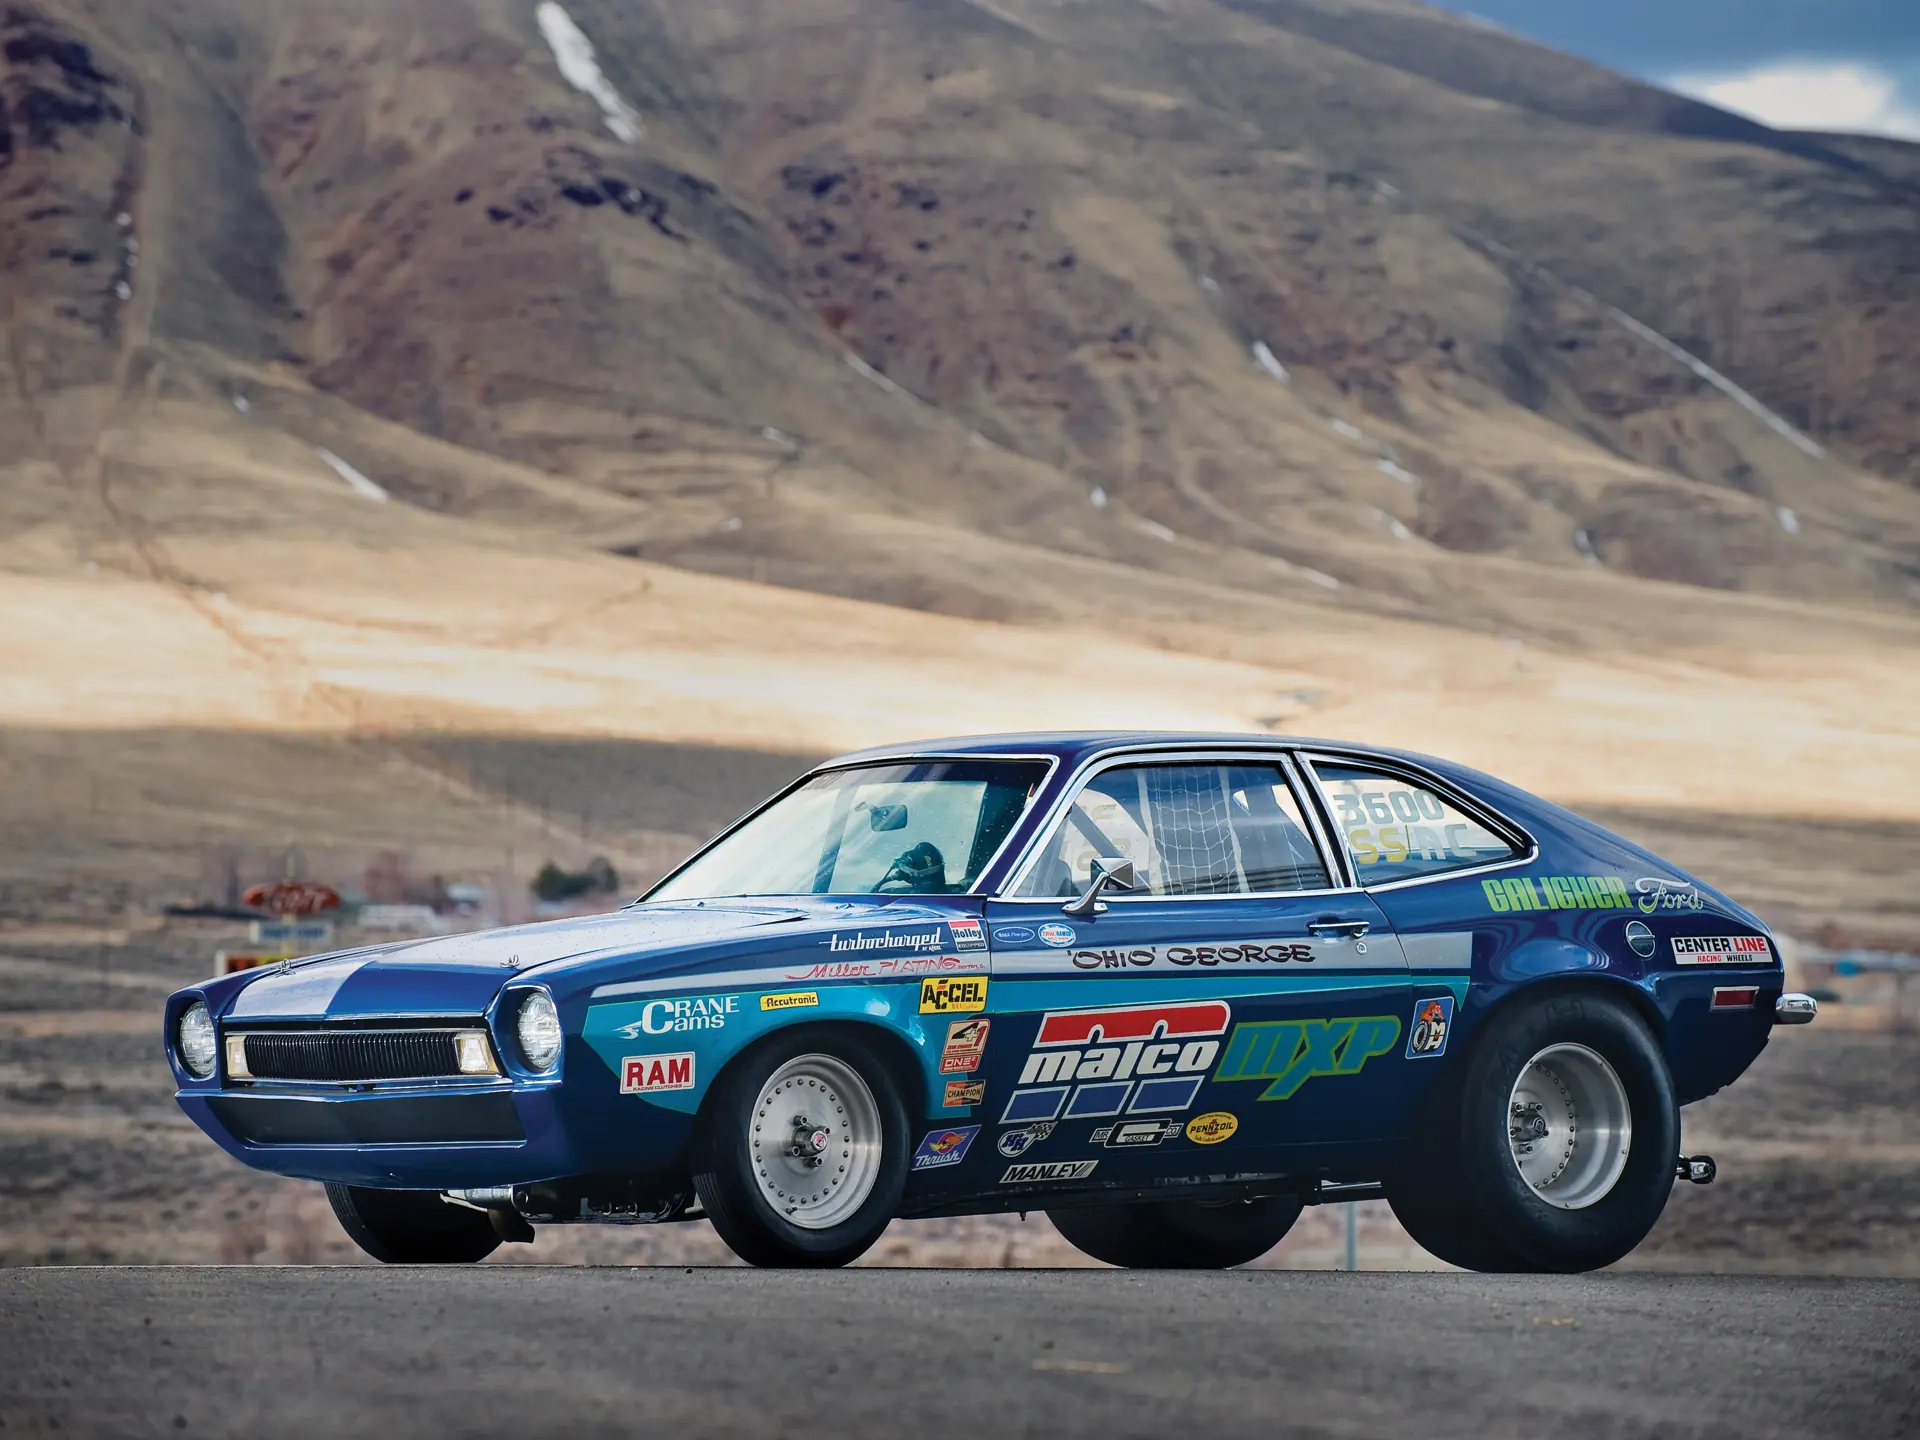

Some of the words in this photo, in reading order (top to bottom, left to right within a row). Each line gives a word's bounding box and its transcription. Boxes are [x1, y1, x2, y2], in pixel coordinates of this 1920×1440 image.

[1333, 789, 1444, 827] 3600
[1481, 876, 1634, 912] GALIGHER
[1635, 877, 1704, 914] Ford
[818, 926, 949, 952] turbocharged
[952, 928, 983, 939] Holley
[1673, 937, 1732, 953] CENTER
[1732, 937, 1767, 952] LINE
[1166, 944, 1316, 966] GEORGE
[1697, 955, 1722, 963] RACING
[1726, 954, 1753, 962] WHEELS
[879, 955, 961, 974] PLATING
[765, 994, 818, 1008] Accutronic
[922, 979, 985, 1010] ACCEL
[641, 996, 740, 1035] CRANE
[626, 1057, 690, 1087] RAM
[1017, 1041, 1221, 1085] malco
[654, 1083, 683, 1091] CLUTCHES
[947, 1089, 981, 1098] CHAMPION
[1189, 1122, 1234, 1134] PENNZOIL
[915, 1150, 961, 1168] Thrush
[1004, 1163, 1084, 1181] MANLEY
